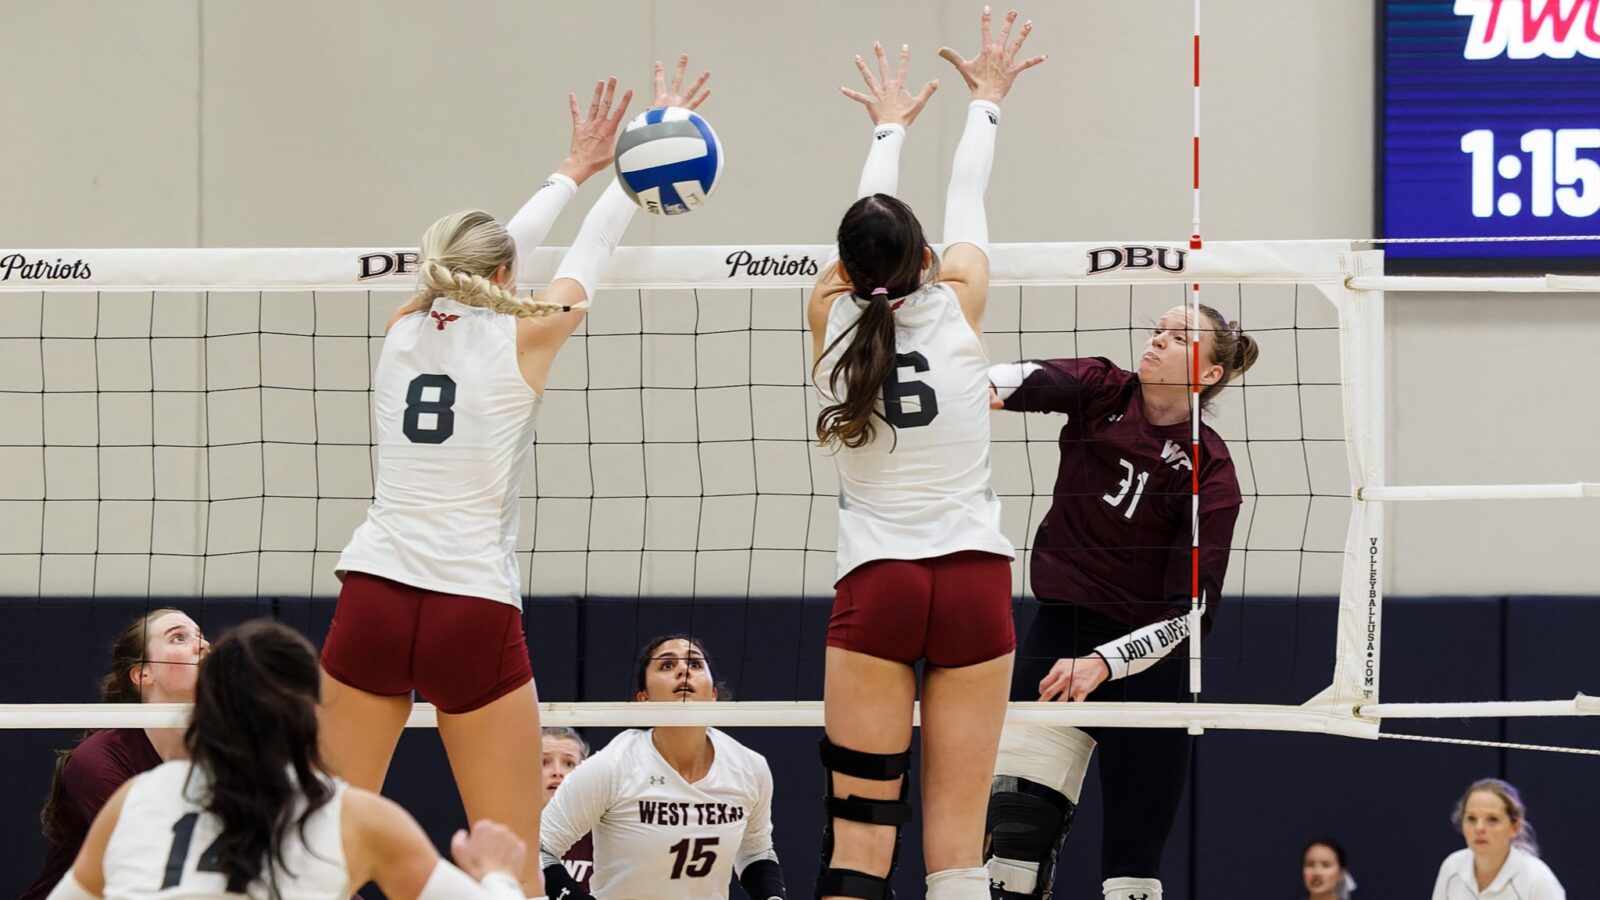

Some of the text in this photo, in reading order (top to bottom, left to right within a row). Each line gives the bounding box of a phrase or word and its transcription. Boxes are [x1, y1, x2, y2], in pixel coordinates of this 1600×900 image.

[1460, 129, 1600, 218] 1:15
[0, 253, 91, 281] Patriots
[358, 251, 420, 281] DB
[725, 250, 818, 278] Patriots
[1086, 244, 1188, 275] DBU
[883, 350, 939, 429] 6
[402, 373, 457, 445] 8
[1102, 457, 1149, 520] 31
[1116, 634, 1154, 663] LADY
[638, 800, 690, 826] WEST
[669, 836, 720, 880] 15
